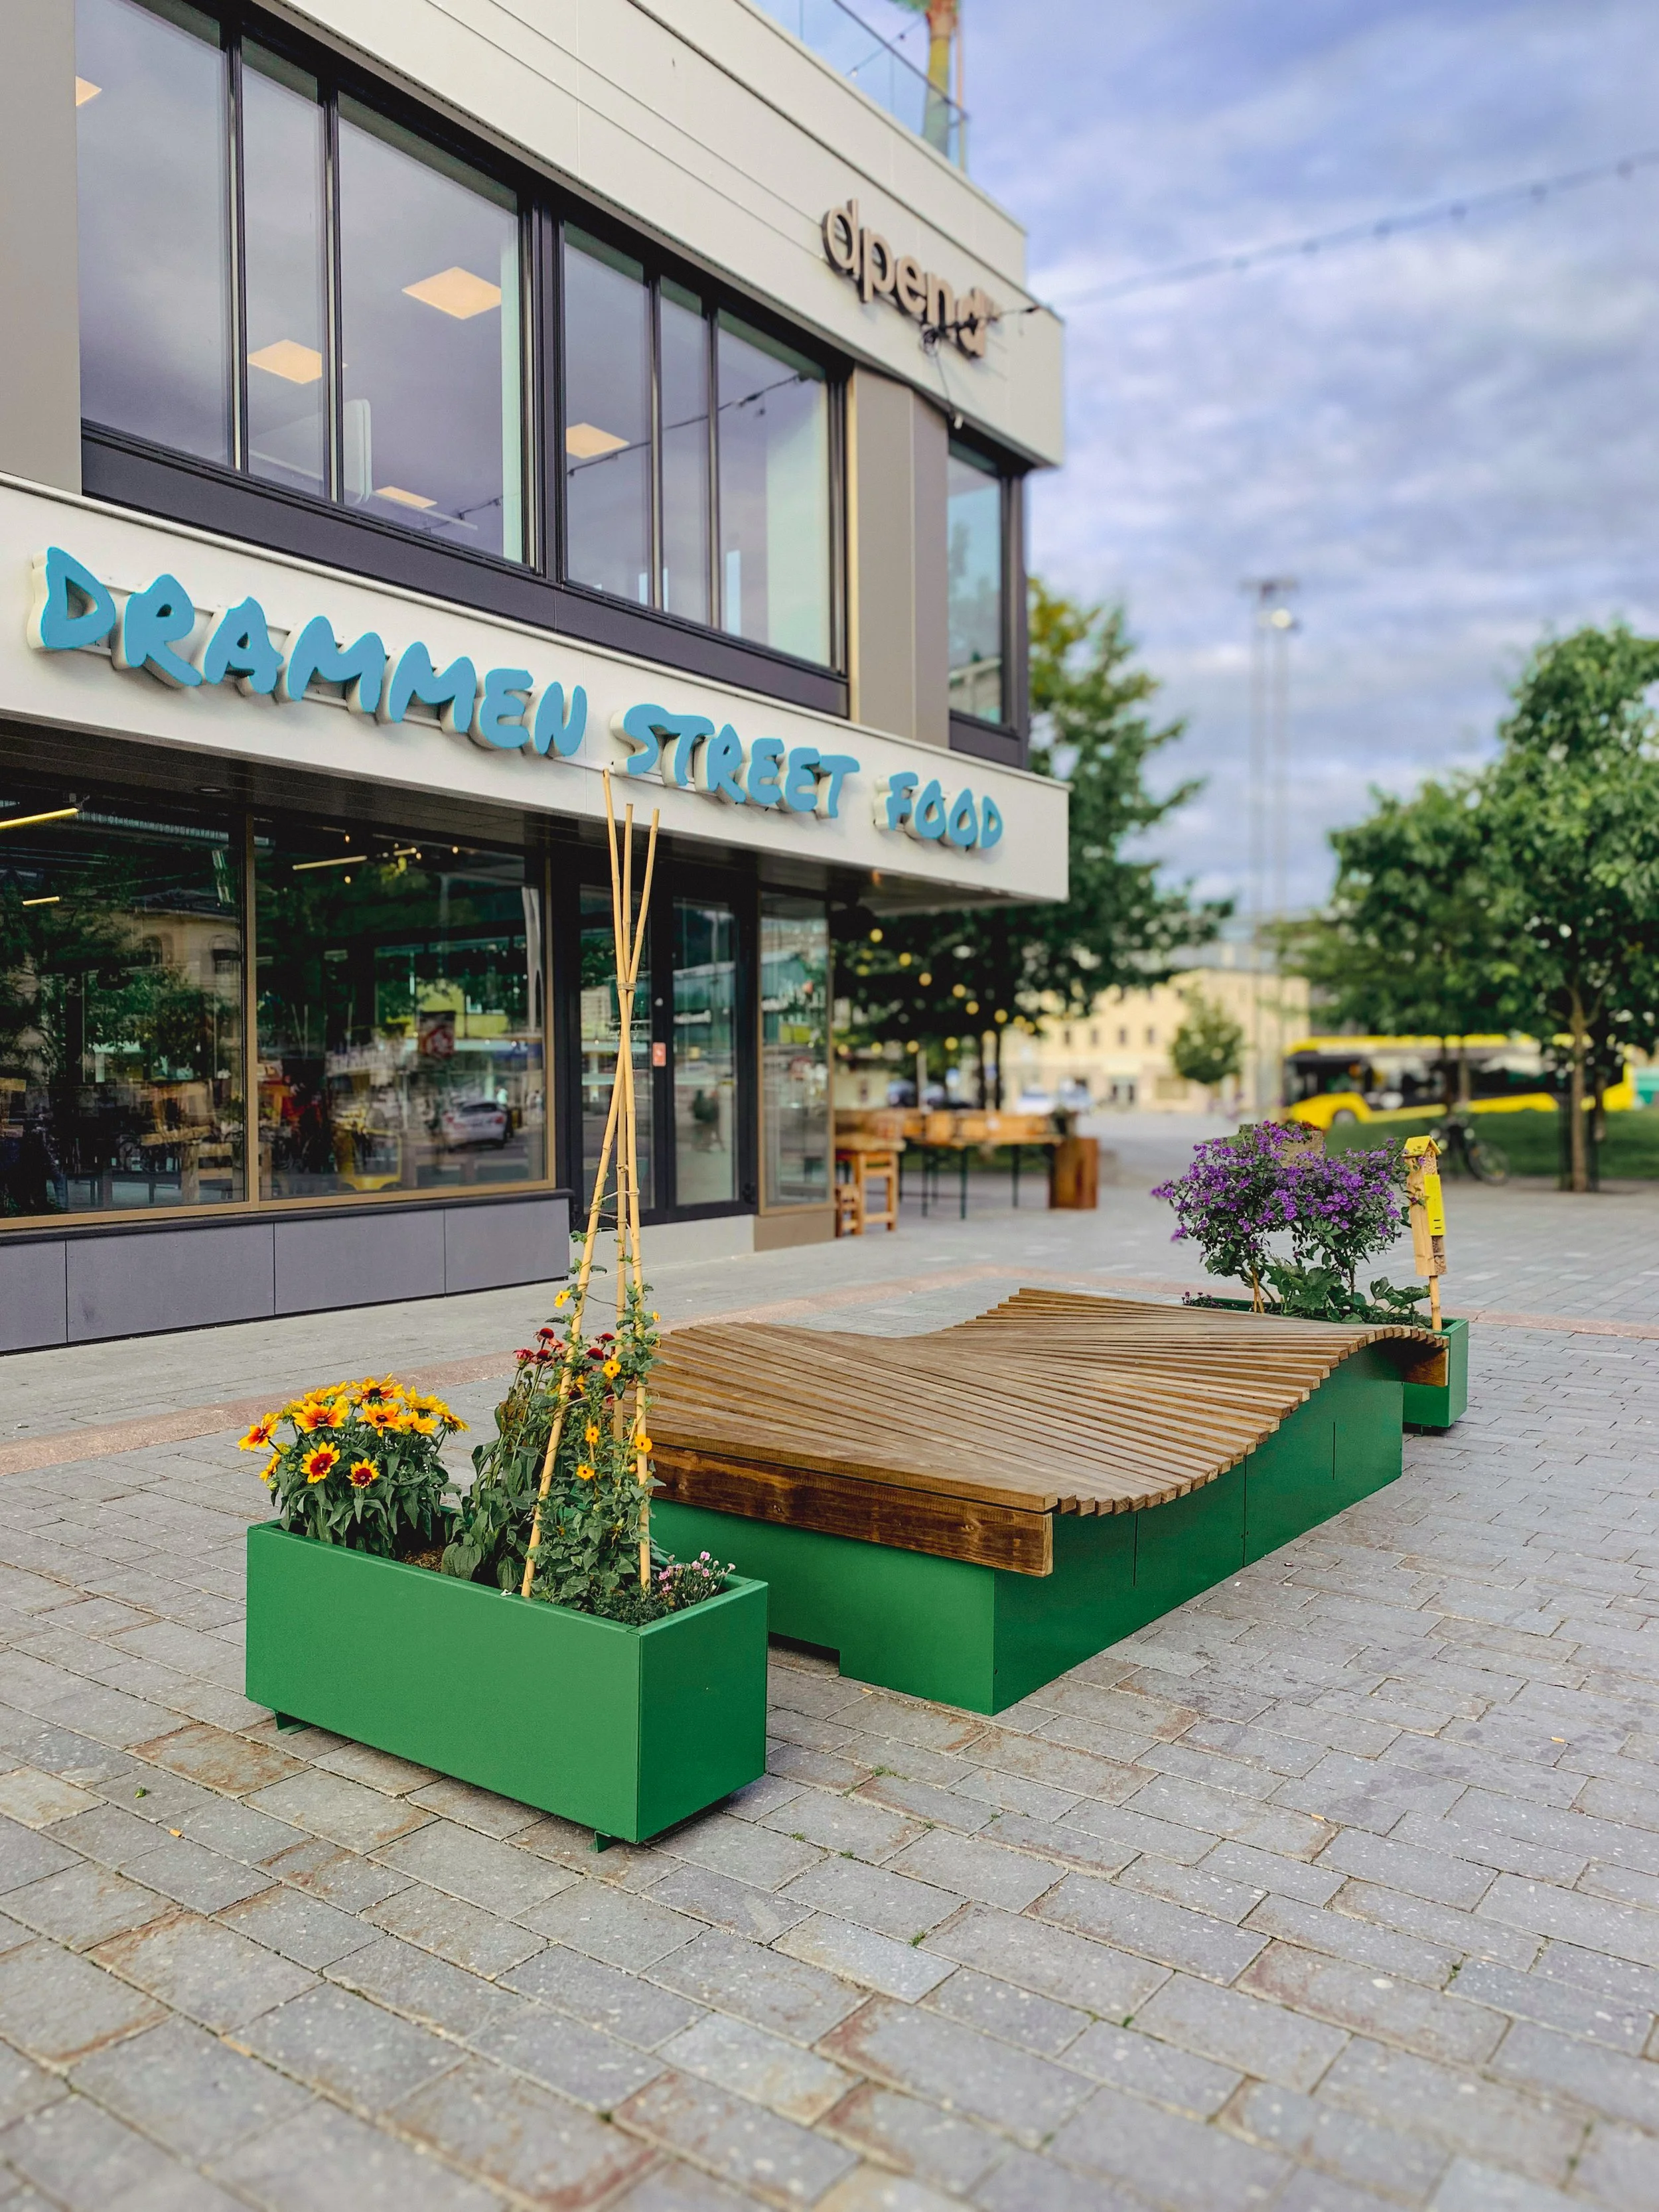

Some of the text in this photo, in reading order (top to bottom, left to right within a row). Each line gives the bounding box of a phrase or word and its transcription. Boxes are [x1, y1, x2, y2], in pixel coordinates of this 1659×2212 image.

[822, 198, 987, 359] dpend
[38, 546, 1003, 849] DRAMMEN STREET FOOD
